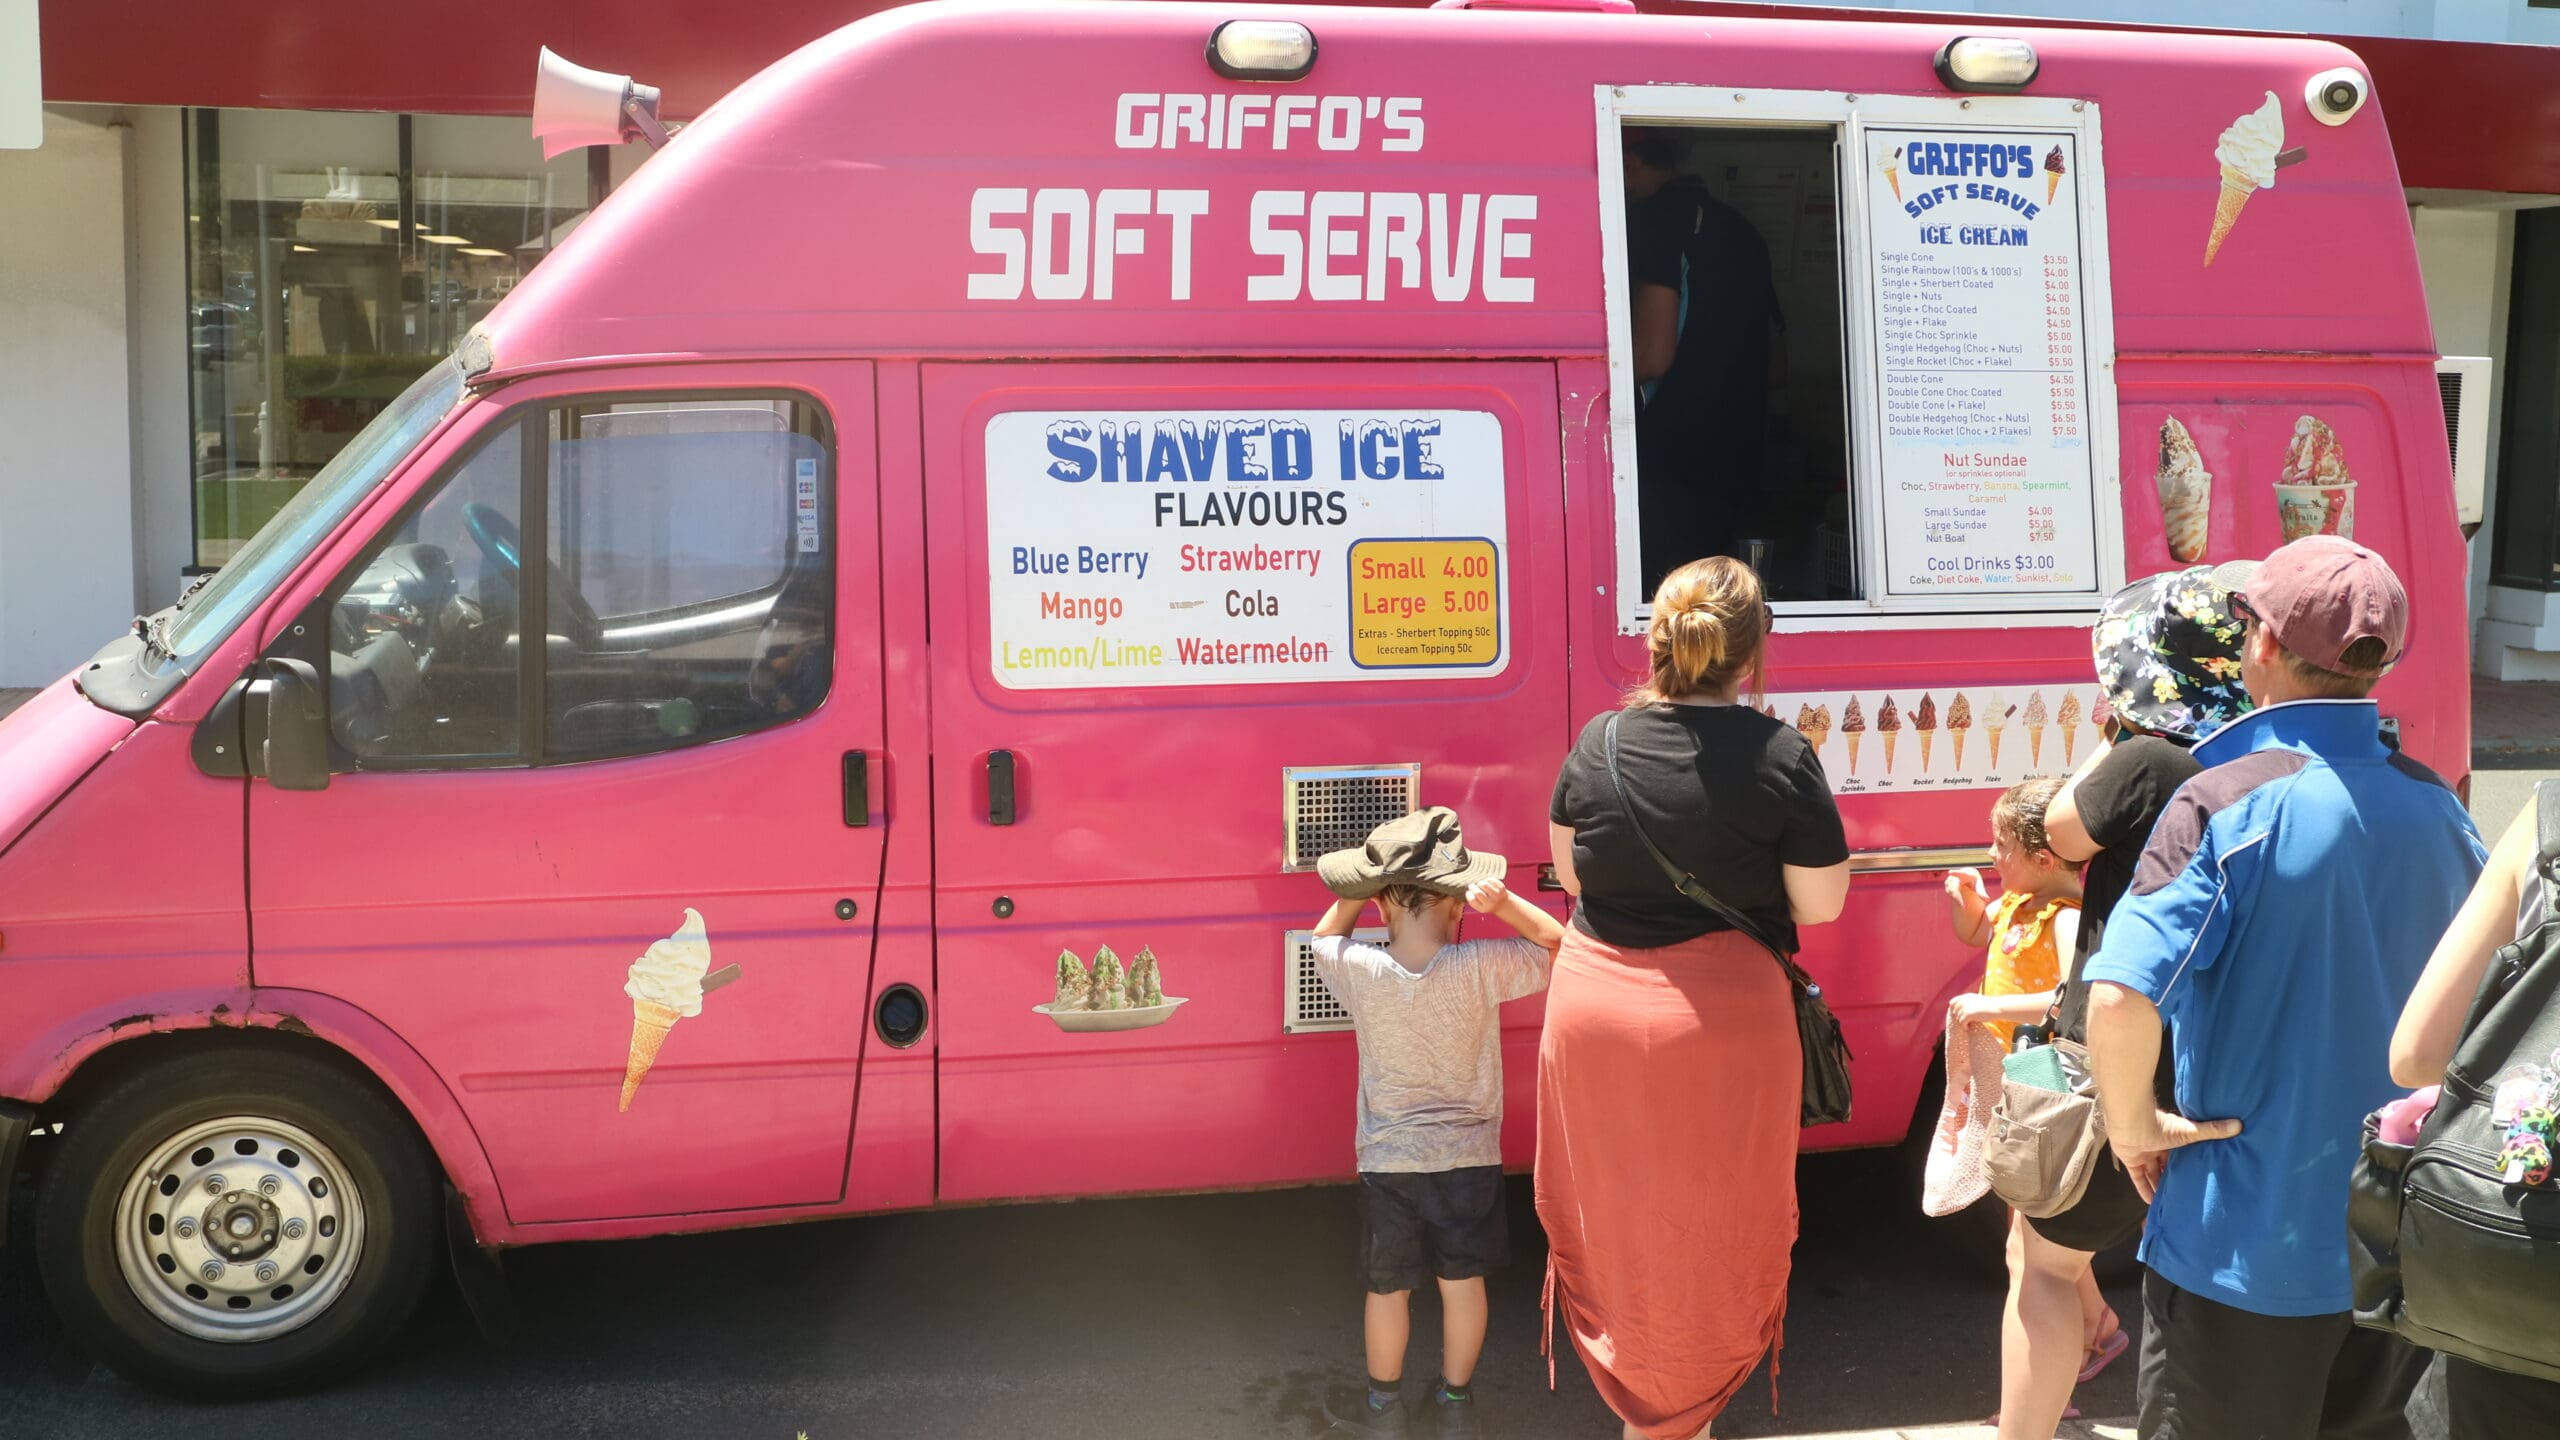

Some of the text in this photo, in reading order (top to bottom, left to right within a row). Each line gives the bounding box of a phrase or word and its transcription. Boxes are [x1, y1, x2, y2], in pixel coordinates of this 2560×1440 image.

[1115, 92, 1424, 152] GRIFFO'S
[1907, 142, 2034, 178] GRIFFO'S
[1904, 183, 2041, 221] SOFT SERVE
[1920, 223, 2028, 246] ICE CREAM
[967, 187, 1538, 303] SOFT SERVE
[1881, 252, 1934, 263] Single Cone
[2044, 255, 2068, 265] $3.50
[1881, 265, 1910, 276] Single
[1912, 266, 1950, 275] Rainbow
[2044, 268, 2068, 278] $4.00
[1882, 278, 1910, 288] Single
[1920, 279, 1960, 288] Sherbert
[1963, 279, 1994, 288] Coated
[2045, 281, 2069, 290] $4.00
[1883, 291, 1911, 301] Single
[1921, 292, 1942, 301] Nuts
[2045, 293, 2069, 303] $4.00
[1883, 304, 1911, 315] Single
[1921, 305, 1944, 314] Choc
[1946, 305, 1977, 314] Coated
[2046, 306, 2070, 316] $4.50
[1884, 317, 1912, 328] Single
[1922, 318, 1947, 327] Flake
[2047, 319, 2071, 329] $4.50
[1885, 330, 1978, 341] Single Choc Sprinkle
[2047, 331, 2071, 341] $5.00
[1885, 343, 1913, 354] Single
[1916, 344, 1961, 354] Hedgehog
[2048, 345, 2072, 354] $5.00
[1886, 356, 1914, 366] Single
[1917, 357, 1947, 366] Rocket
[2049, 357, 2073, 367] $5.50
[1887, 374, 1944, 384] Double Cone
[2050, 375, 2074, 385] $4.50
[1888, 388, 2002, 397] Double Cone Choc Coated
[2050, 388, 2074, 397] $5.50
[1888, 401, 1920, 410] Double
[1922, 401, 1945, 410] Cone
[2051, 401, 2075, 410] $5.50
[1889, 414, 1920, 423] Double
[1923, 414, 1968, 424] Hedgehog
[2052, 414, 2076, 423] $6.50
[1889, 427, 1921, 436] Double
[1924, 427, 1954, 436] Rocket
[1991, 427, 1997, 436] 2
[2052, 426, 2077, 436] $7.50
[1046, 418, 1445, 483] SHAVED ICE
[1944, 453, 2027, 467] Nut Sundae
[1959, 470, 1993, 479] sprinkles
[1901, 482, 1927, 492] Choc,
[1928, 481, 1982, 492] Strawberry,
[2022, 481, 2072, 491] Spearmint,
[1968, 495, 2006, 504] Caramel
[1154, 490, 1348, 528] FLAVOURS
[1924, 507, 1986, 516] Small Sundae
[2028, 507, 2053, 516] $4.00
[1925, 521, 1987, 531] Large Sundae
[2029, 519, 2053, 529] $5.00
[1926, 534, 1965, 543] Nut Boat
[2029, 532, 2054, 542] $7.50
[1012, 546, 1149, 579] Blue Berry
[1180, 543, 1321, 576] Strawberry
[1927, 555, 2054, 571] Cool Drinks $3.00
[1361, 555, 1489, 580] Small 4.00
[1910, 575, 1935, 585] Coke,
[1937, 575, 1956, 584] Diet
[1957, 575, 1982, 585] Coke,
[1985, 575, 2013, 584] Water,
[2015, 574, 2052, 583] Sunkist,
[1225, 590, 1280, 617] Cola
[1362, 590, 1490, 619] Large 5.00
[1040, 592, 1124, 626] Mango
[1358, 628, 1387, 640] Extras
[1396, 626, 1437, 639] Sherbert
[1438, 626, 1474, 640] Topping
[1474, 625, 1491, 638] 50c
[1177, 636, 1329, 666] Watermelon
[1377, 642, 1473, 657] Icecream Topping 50c
[1002, 639, 1163, 672] Lemon/Lime
